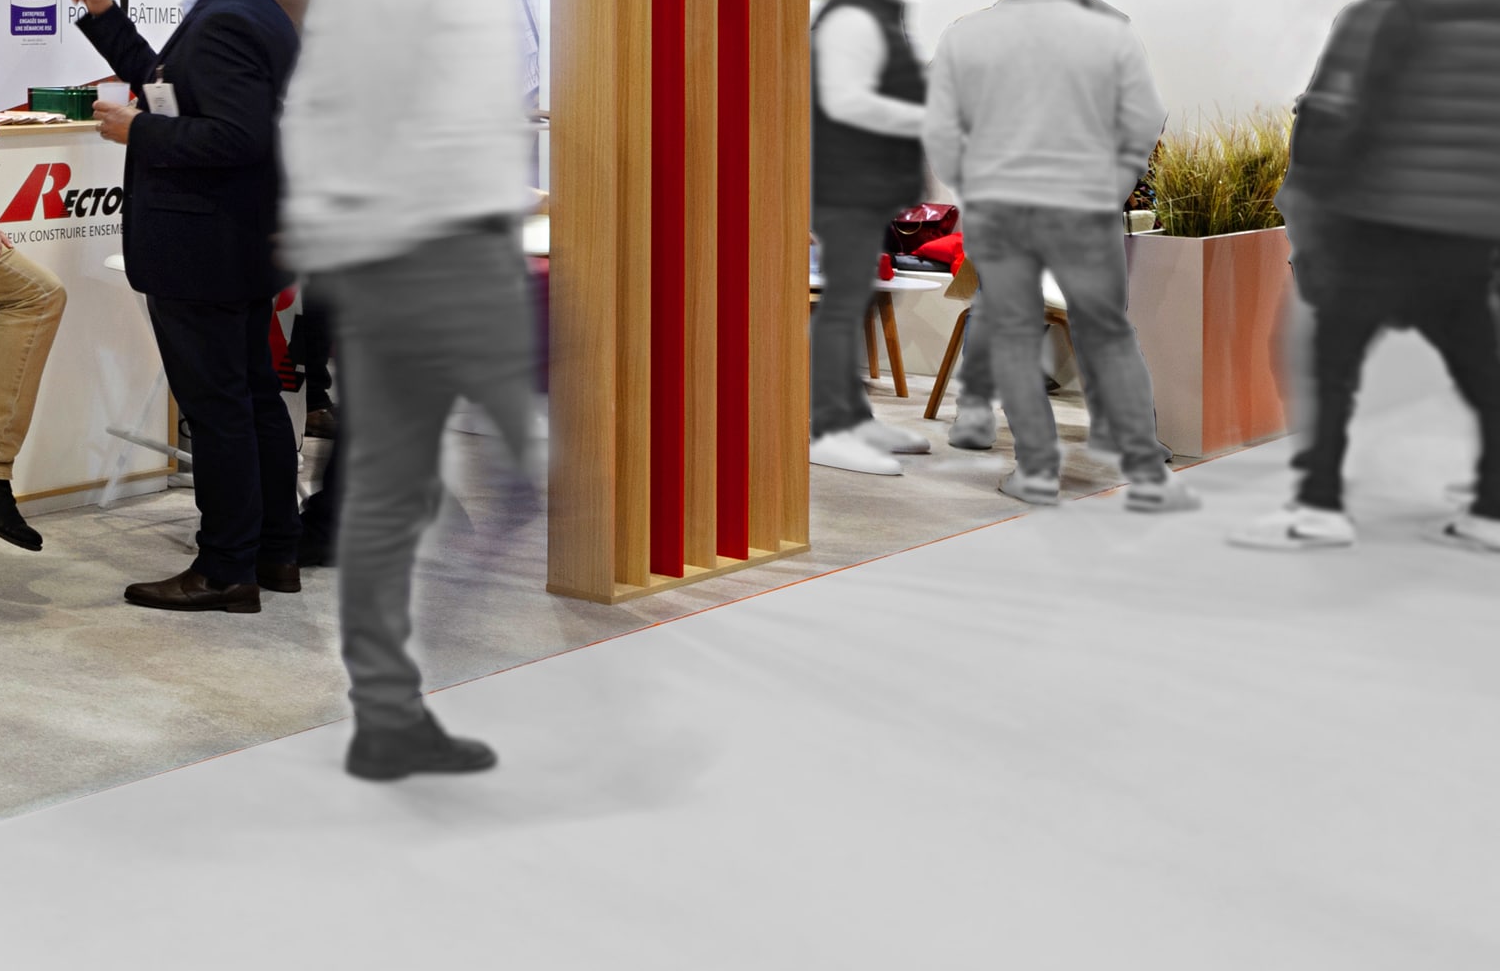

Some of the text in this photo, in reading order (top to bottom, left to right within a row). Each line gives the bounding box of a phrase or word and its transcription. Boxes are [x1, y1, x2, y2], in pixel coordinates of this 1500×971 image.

[130, 2, 185, 24] BÂTIMEN
[6, 223, 123, 244] EUX CONSTRUIRE ENSEMB
